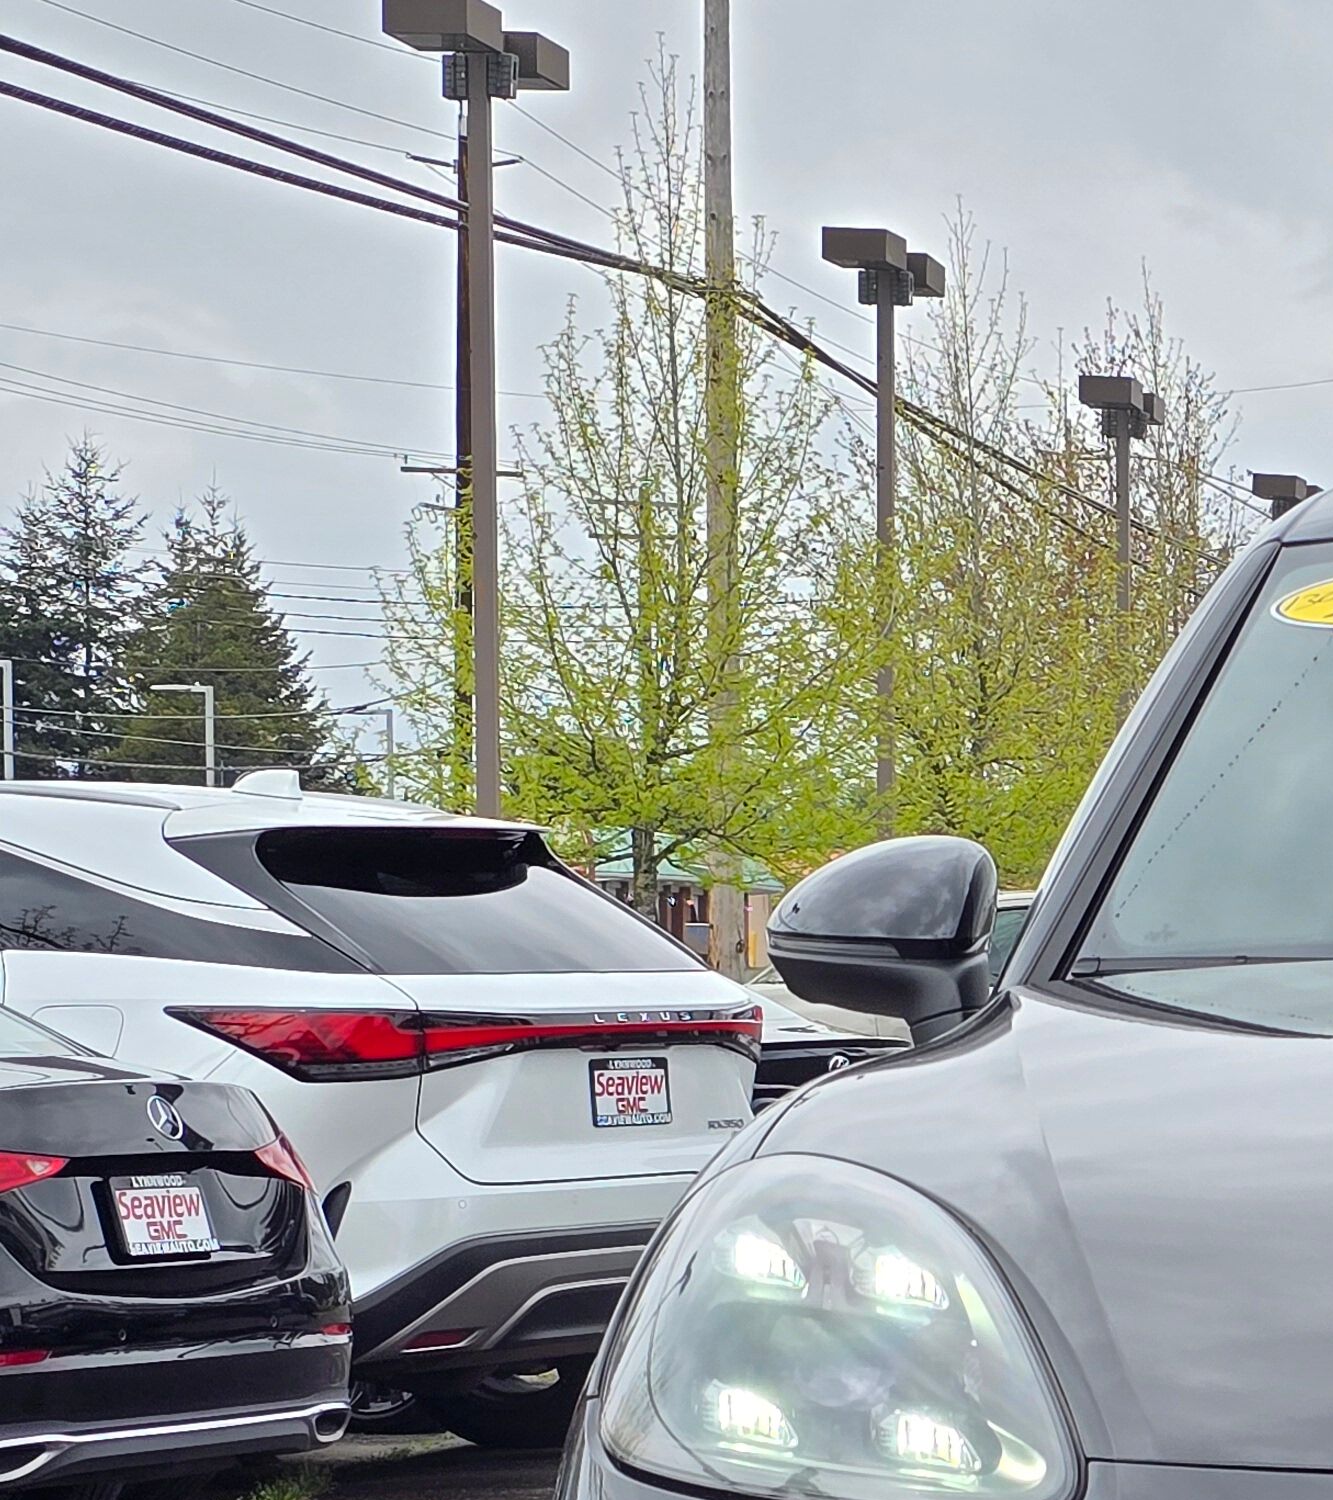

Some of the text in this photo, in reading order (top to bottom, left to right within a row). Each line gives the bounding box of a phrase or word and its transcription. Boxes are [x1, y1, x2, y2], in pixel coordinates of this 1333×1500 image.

[594, 1011, 692, 1023] LEXUS
[596, 1071, 664, 1097] Seaview
[616, 1097, 648, 1114] GMC
[131, 1175, 183, 1188] LYNNWOOD
[119, 1189, 200, 1220] Seaview
[147, 1220, 188, 1241] GMC
